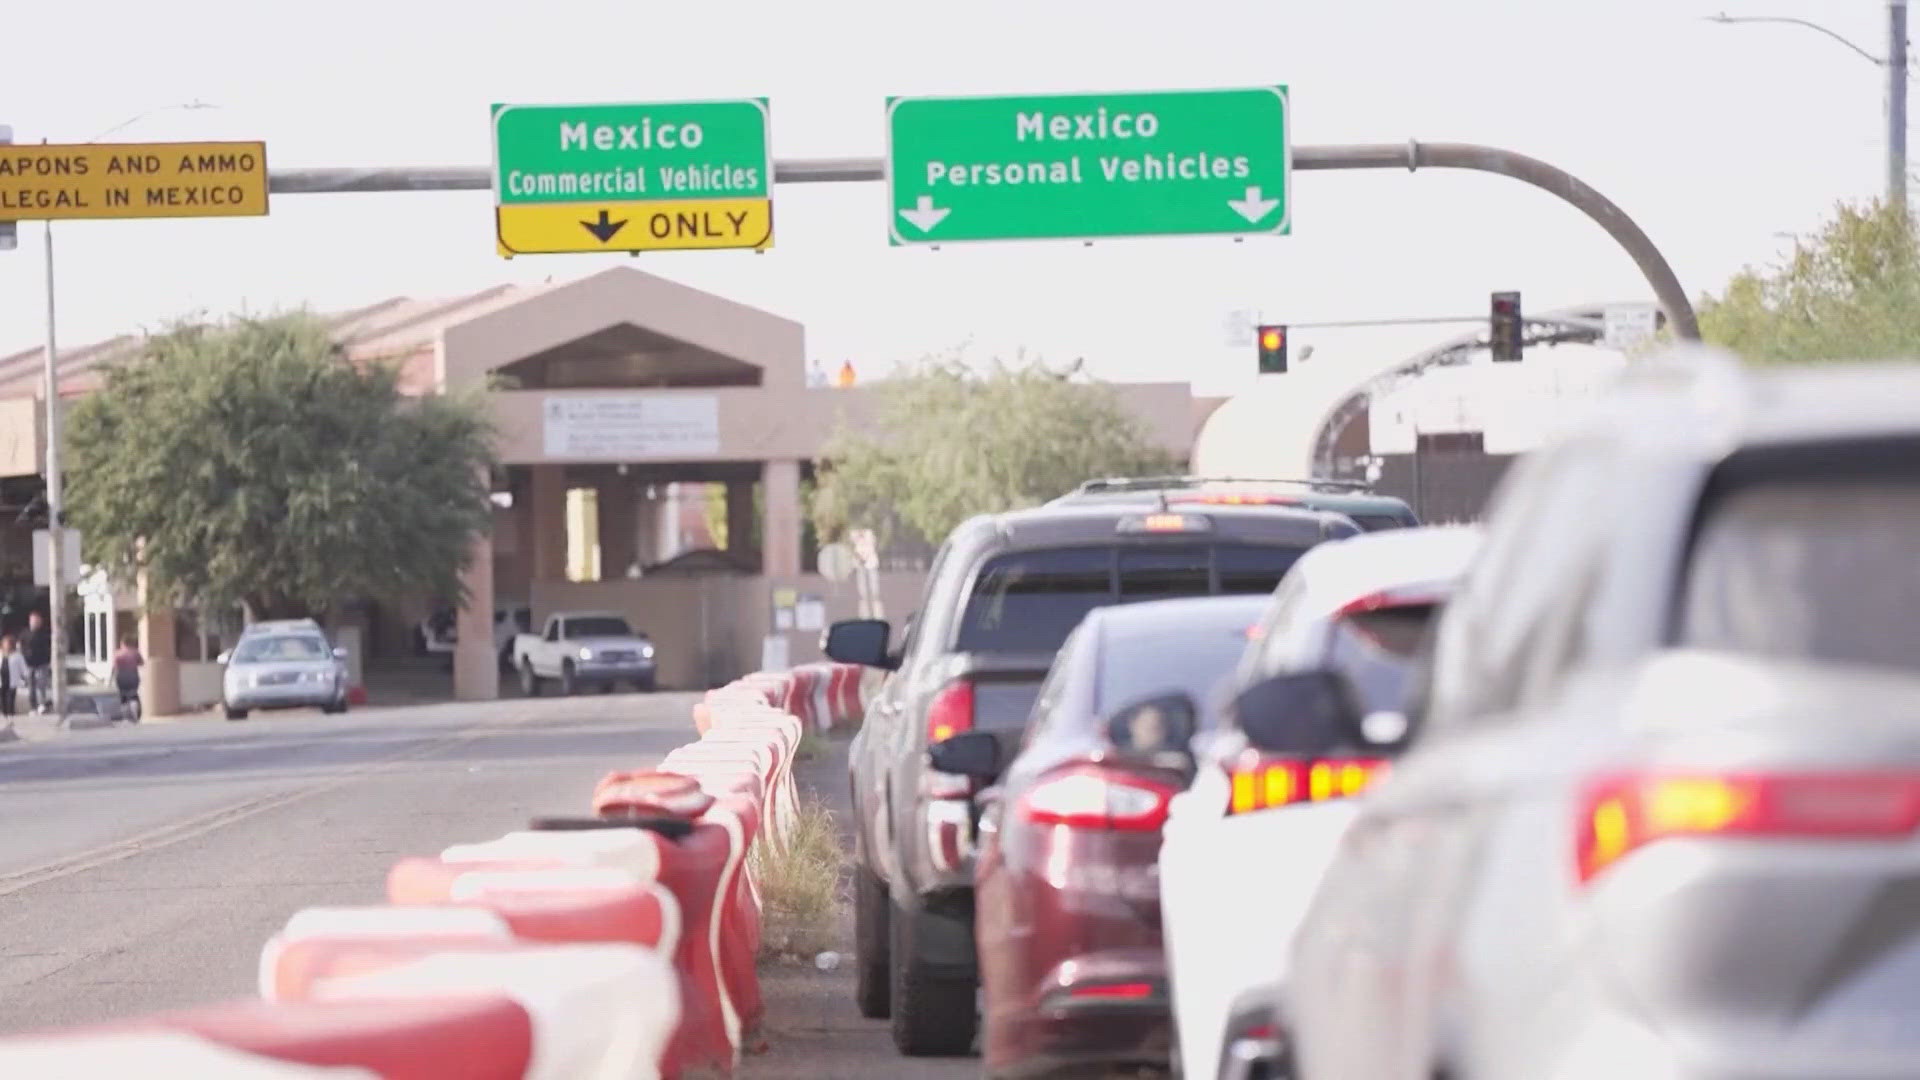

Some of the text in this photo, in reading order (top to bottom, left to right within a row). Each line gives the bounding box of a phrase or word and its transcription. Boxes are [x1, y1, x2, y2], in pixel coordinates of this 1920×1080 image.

[559, 117, 703, 151] Mexico
[1016, 106, 1159, 142] Mexico
[107, 155, 161, 174] AND
[178, 153, 255, 172] AMMO
[508, 163, 759, 196] Commercial Vehicles
[926, 152, 1250, 187] Personal Vehicles
[2, 186, 243, 208] LEGAL IN MEXICO
[650, 211, 748, 239] ONLY
